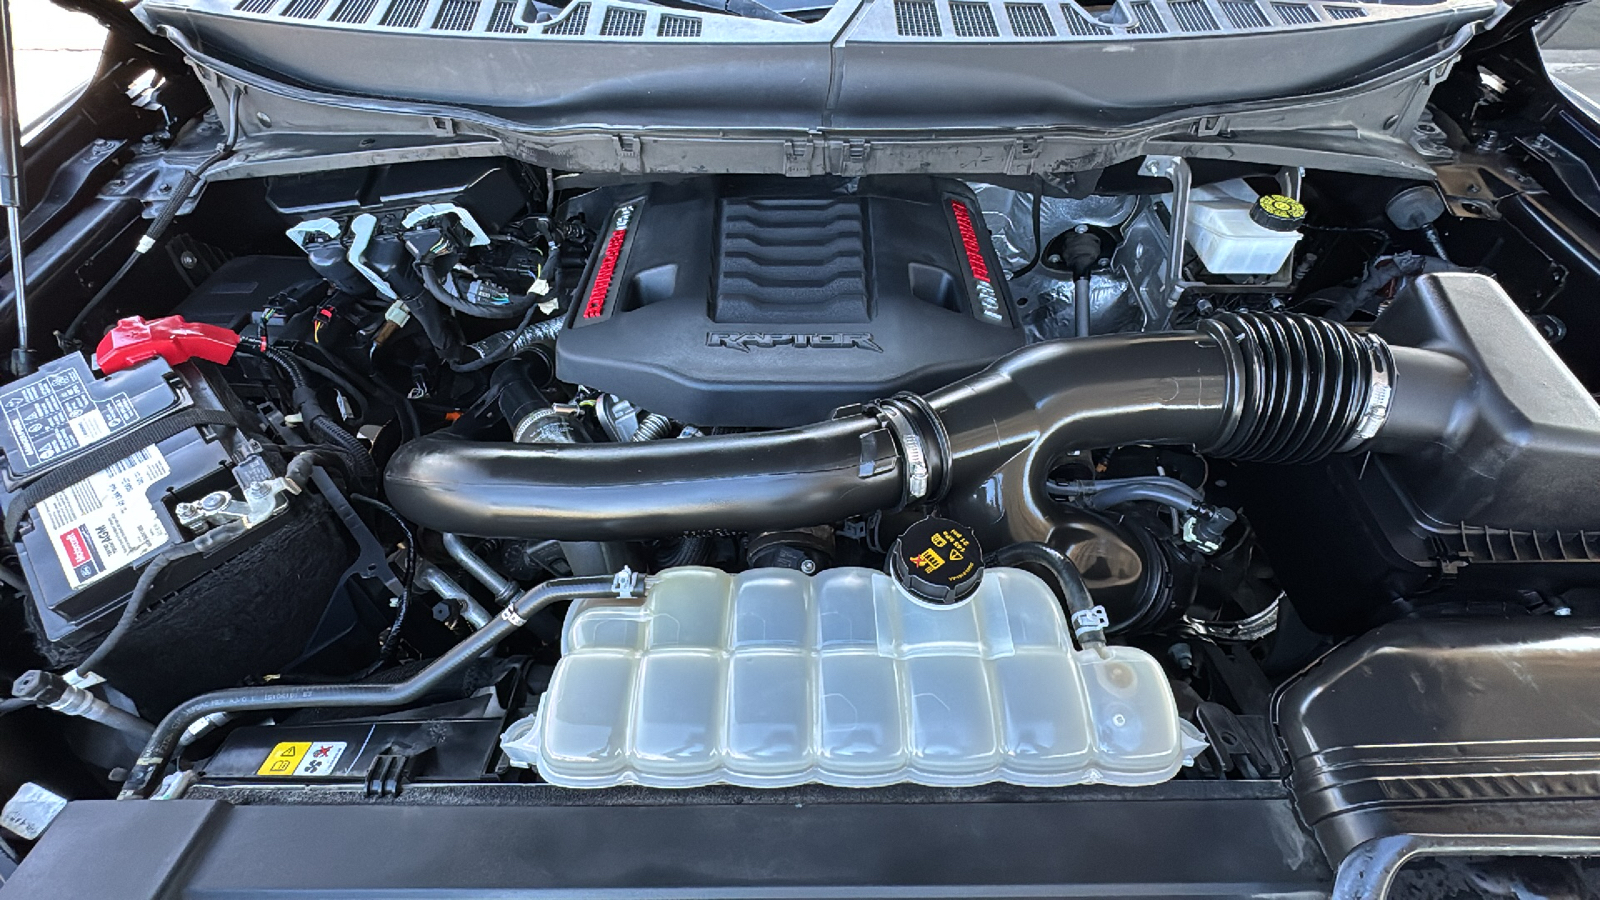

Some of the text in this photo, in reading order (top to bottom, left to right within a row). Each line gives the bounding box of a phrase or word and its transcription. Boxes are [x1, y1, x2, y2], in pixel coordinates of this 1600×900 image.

[705, 331, 884, 354] RAPTOR
[95, 524, 113, 544] AGM
[65, 531, 87, 564] Motorcraft
